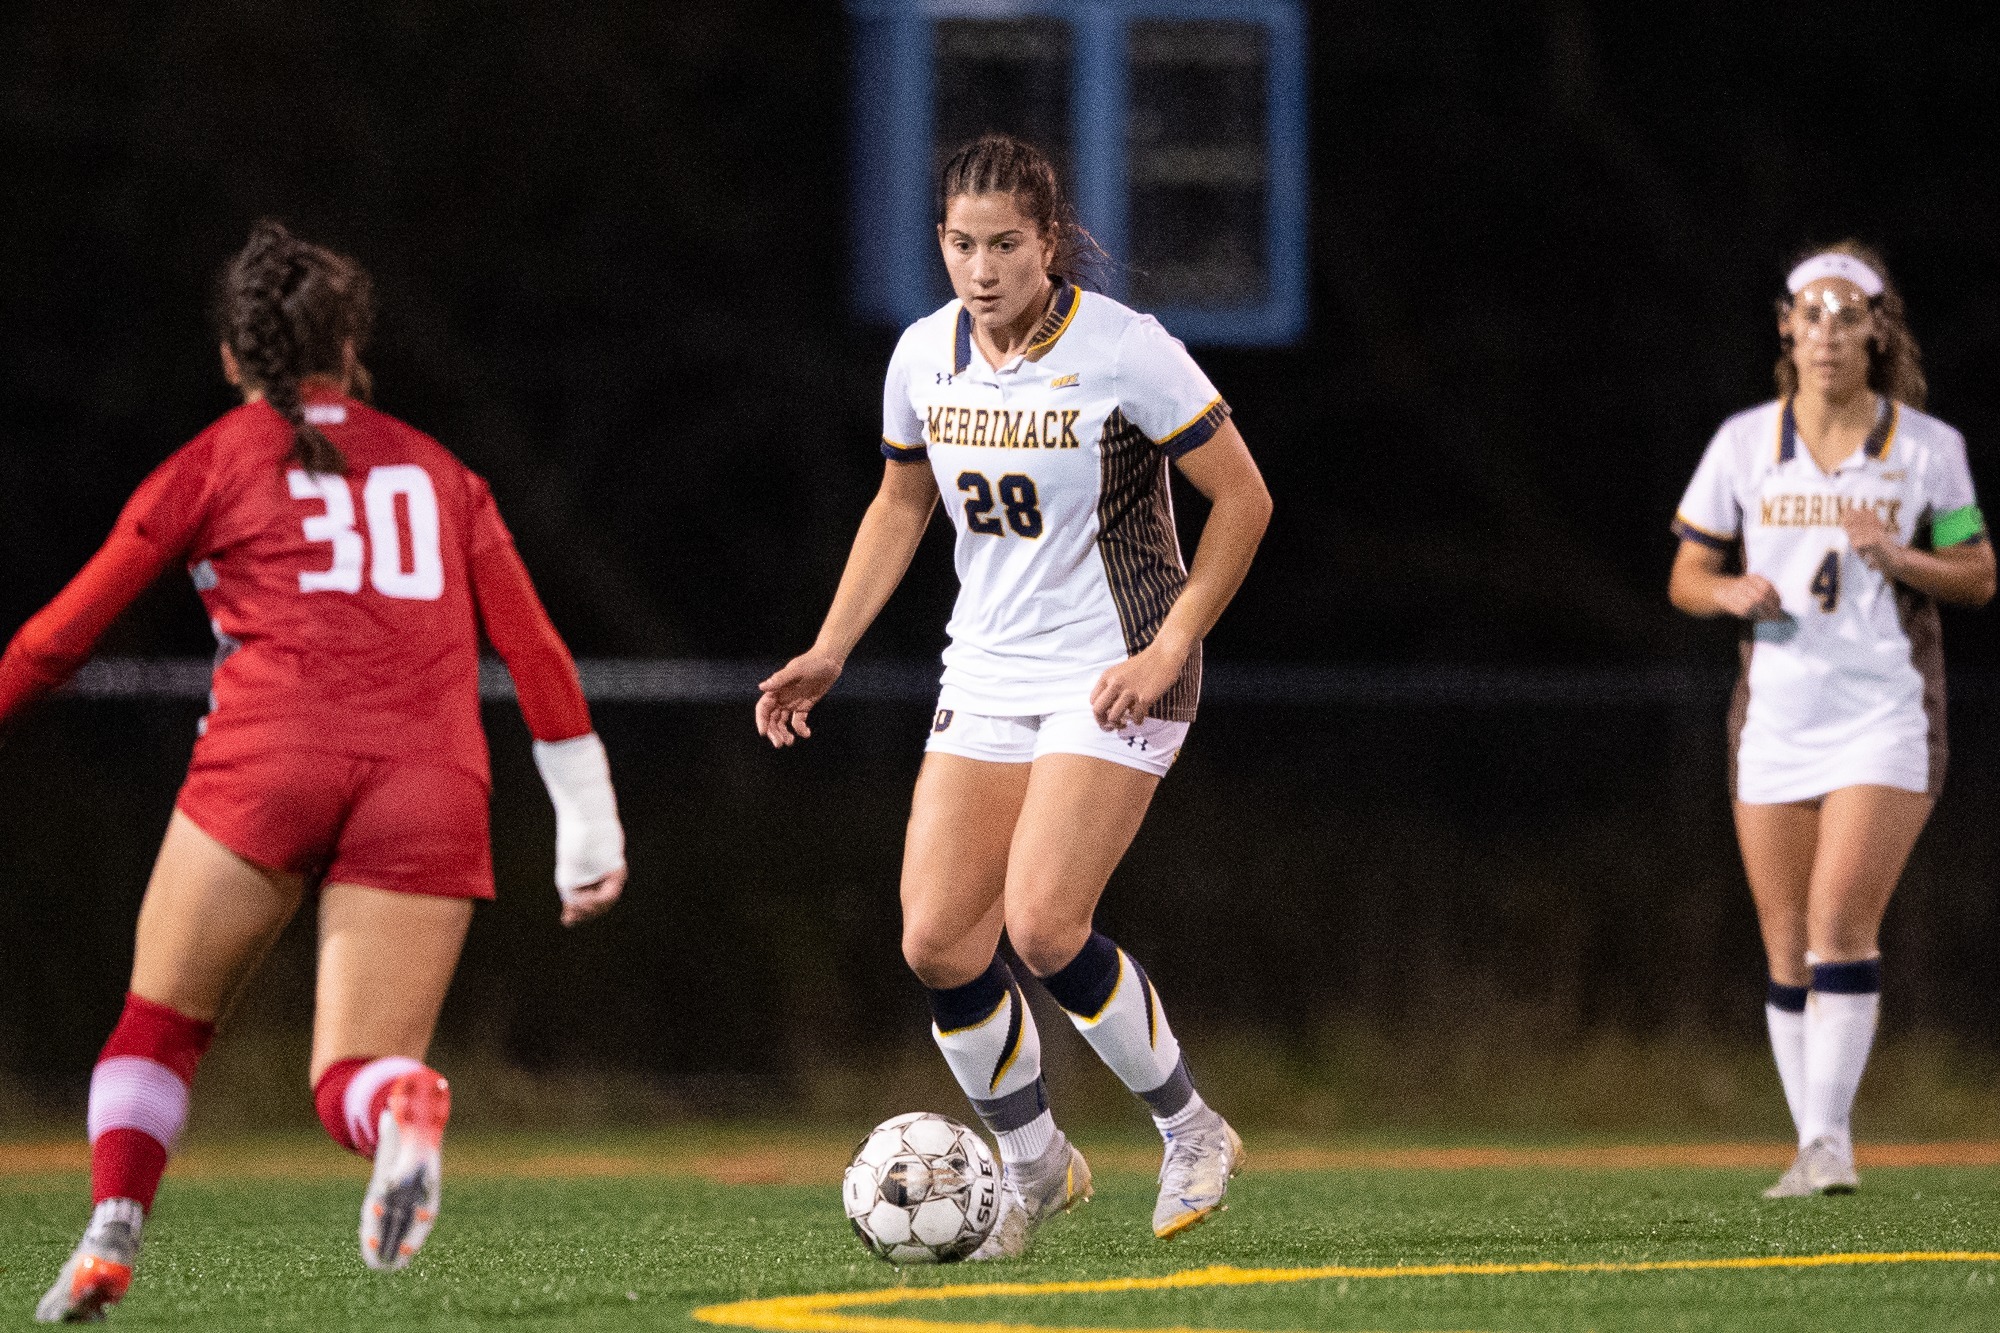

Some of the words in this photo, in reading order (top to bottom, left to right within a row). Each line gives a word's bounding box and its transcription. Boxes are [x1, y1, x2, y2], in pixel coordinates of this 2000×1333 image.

[926, 405, 1081, 449] MERRIMACK
[285, 463, 445, 601] 30
[957, 470, 1044, 540] 28
[1761, 493, 1902, 534] MERRIMK
[1809, 547, 1842, 613] 4
